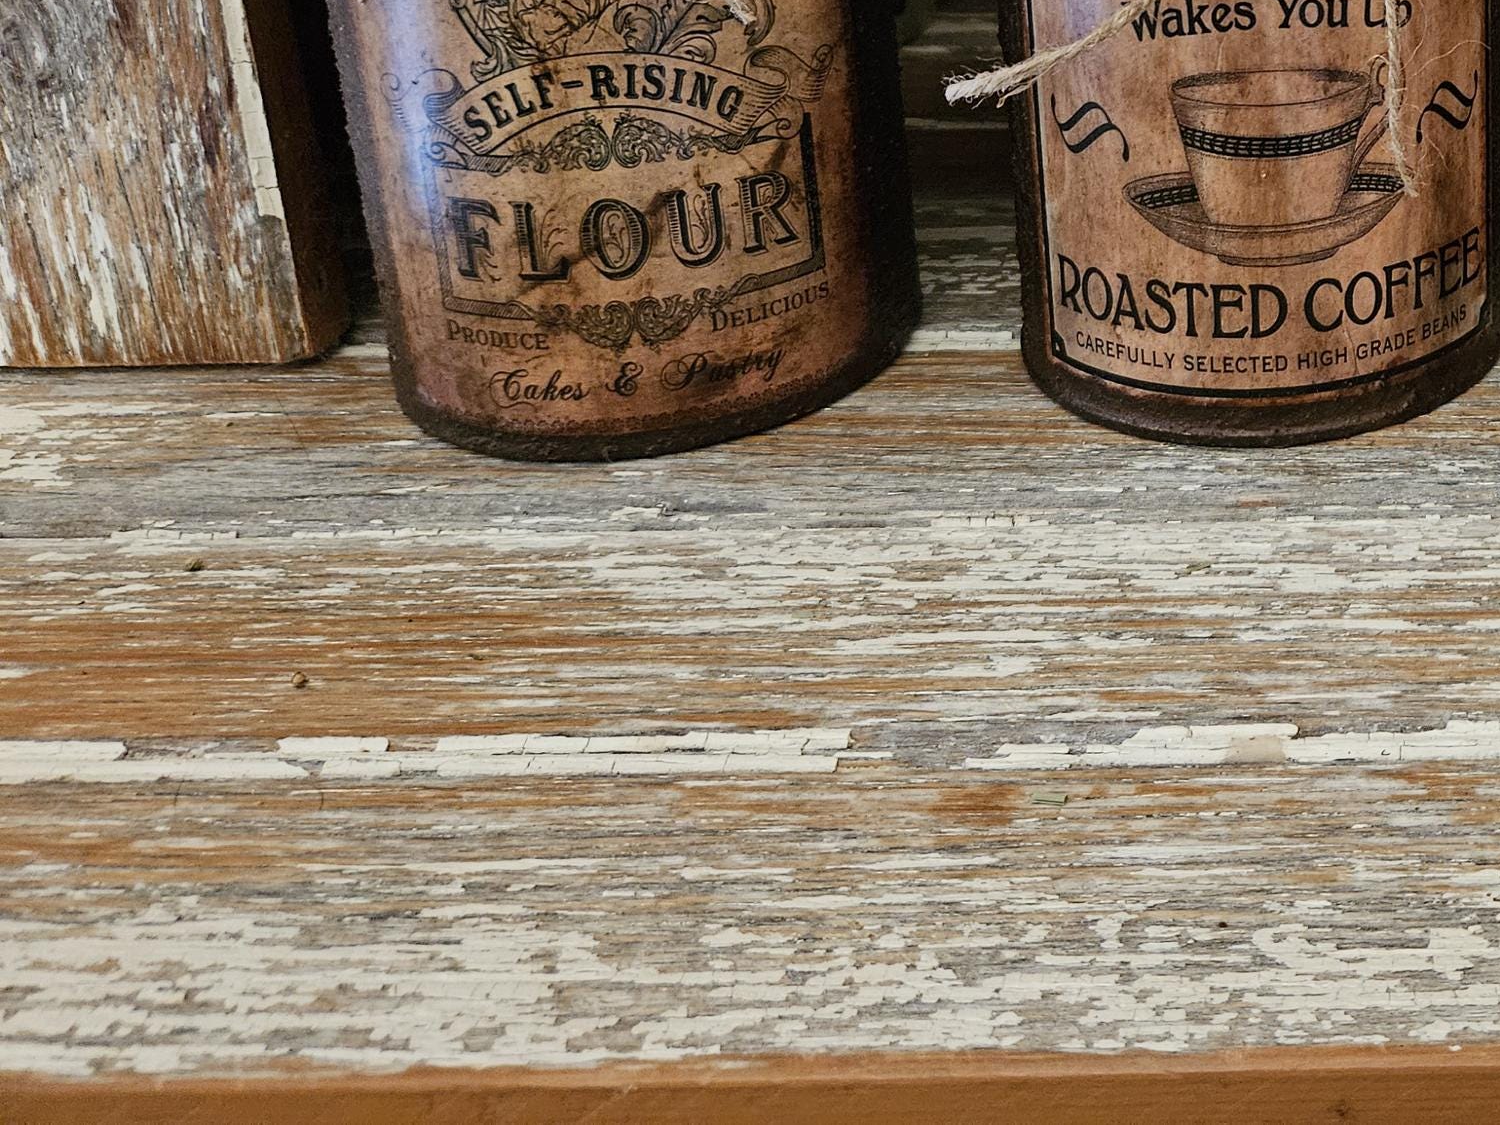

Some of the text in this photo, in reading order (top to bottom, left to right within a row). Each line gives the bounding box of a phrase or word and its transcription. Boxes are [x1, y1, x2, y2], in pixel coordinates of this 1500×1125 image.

[462, 62, 745, 144] SELF-RISING
[444, 170, 802, 284] FLOUR
[446, 281, 830, 352] PRODUCE DELICIOUS
[1057, 226, 1482, 340] ROASTED COFFEE
[1075, 303, 1468, 374] CAREFULLY SELECTED HIGH GRADE BEANS
[487, 346, 788, 408] Cakes & Pastry
